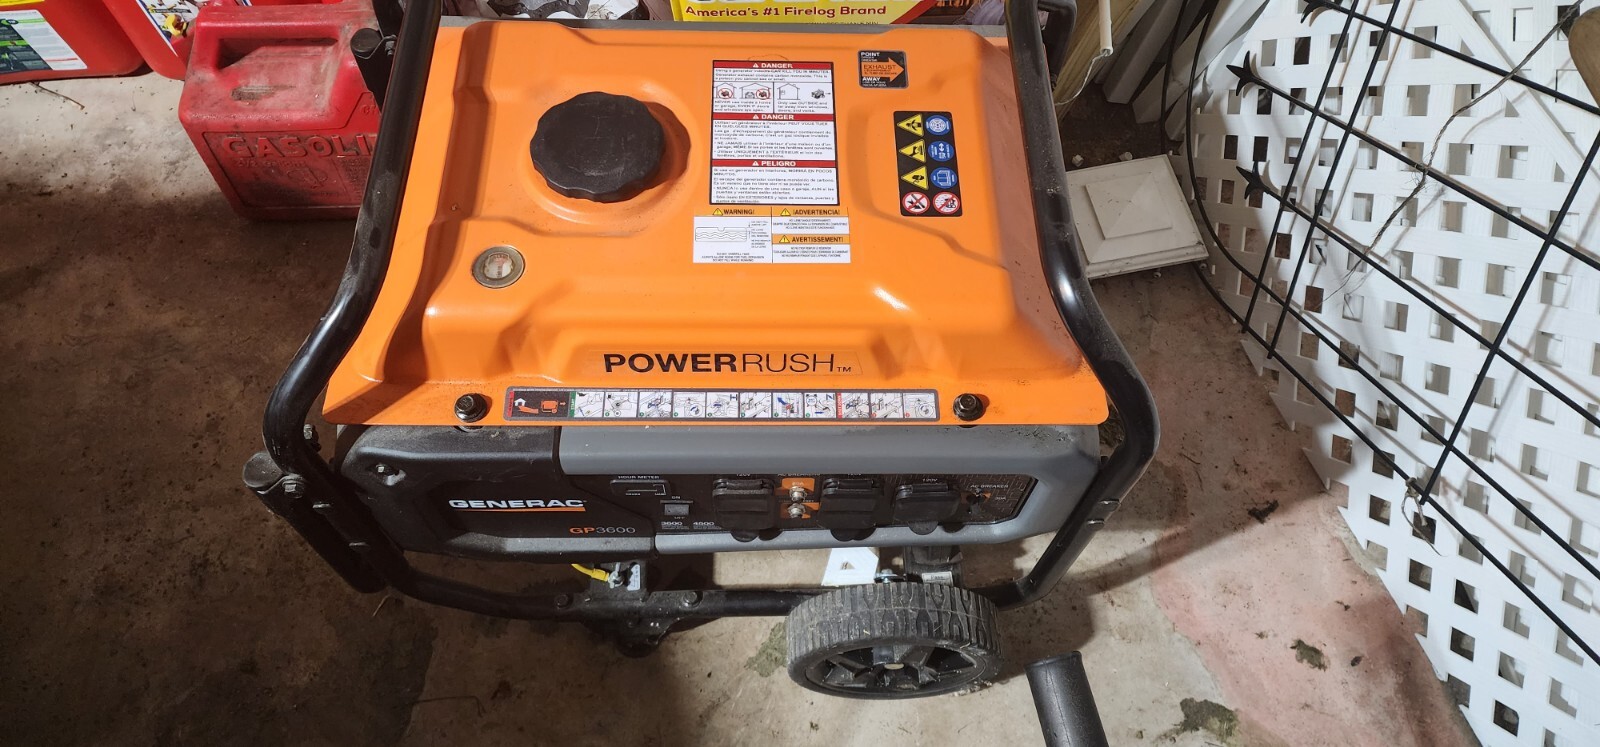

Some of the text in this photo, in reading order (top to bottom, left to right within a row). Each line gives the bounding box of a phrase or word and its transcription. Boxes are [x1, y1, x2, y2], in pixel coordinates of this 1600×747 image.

[685, 5, 887, 18] America's #1 Firelog Brand
[448, 499, 585, 509] GENERAC
[569, 526, 636, 535] GP3600
